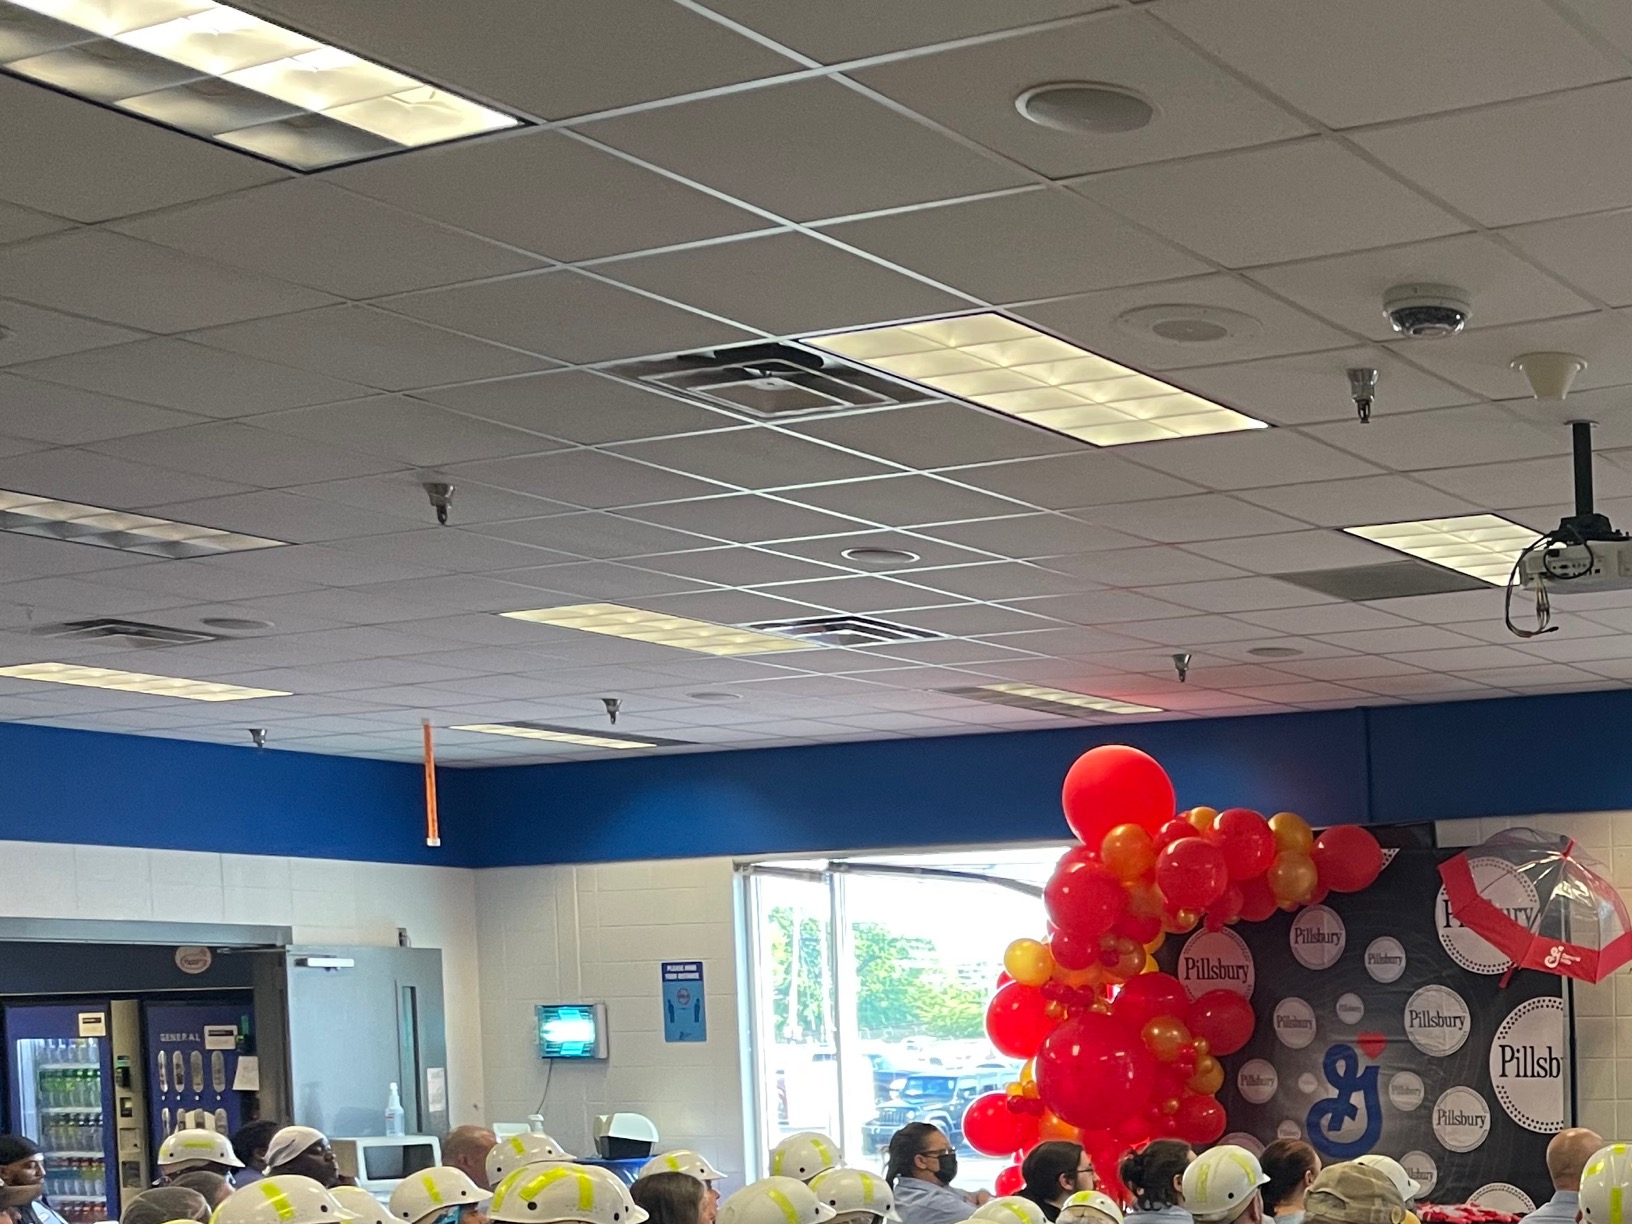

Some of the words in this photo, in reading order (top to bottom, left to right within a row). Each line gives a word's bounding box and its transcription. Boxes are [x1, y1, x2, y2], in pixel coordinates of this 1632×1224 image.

[1294, 927, 1343, 946] Pillsbury
[1367, 953, 1403, 966] Pillsbury
[1184, 957, 1249, 983] Pillsbury
[1276, 1014, 1313, 1030] Pillsbury
[1409, 1010, 1466, 1031] Pillsbury
[1498, 1045, 1563, 1078] Pillsb
[1436, 1109, 1487, 1129] Pillsbury
